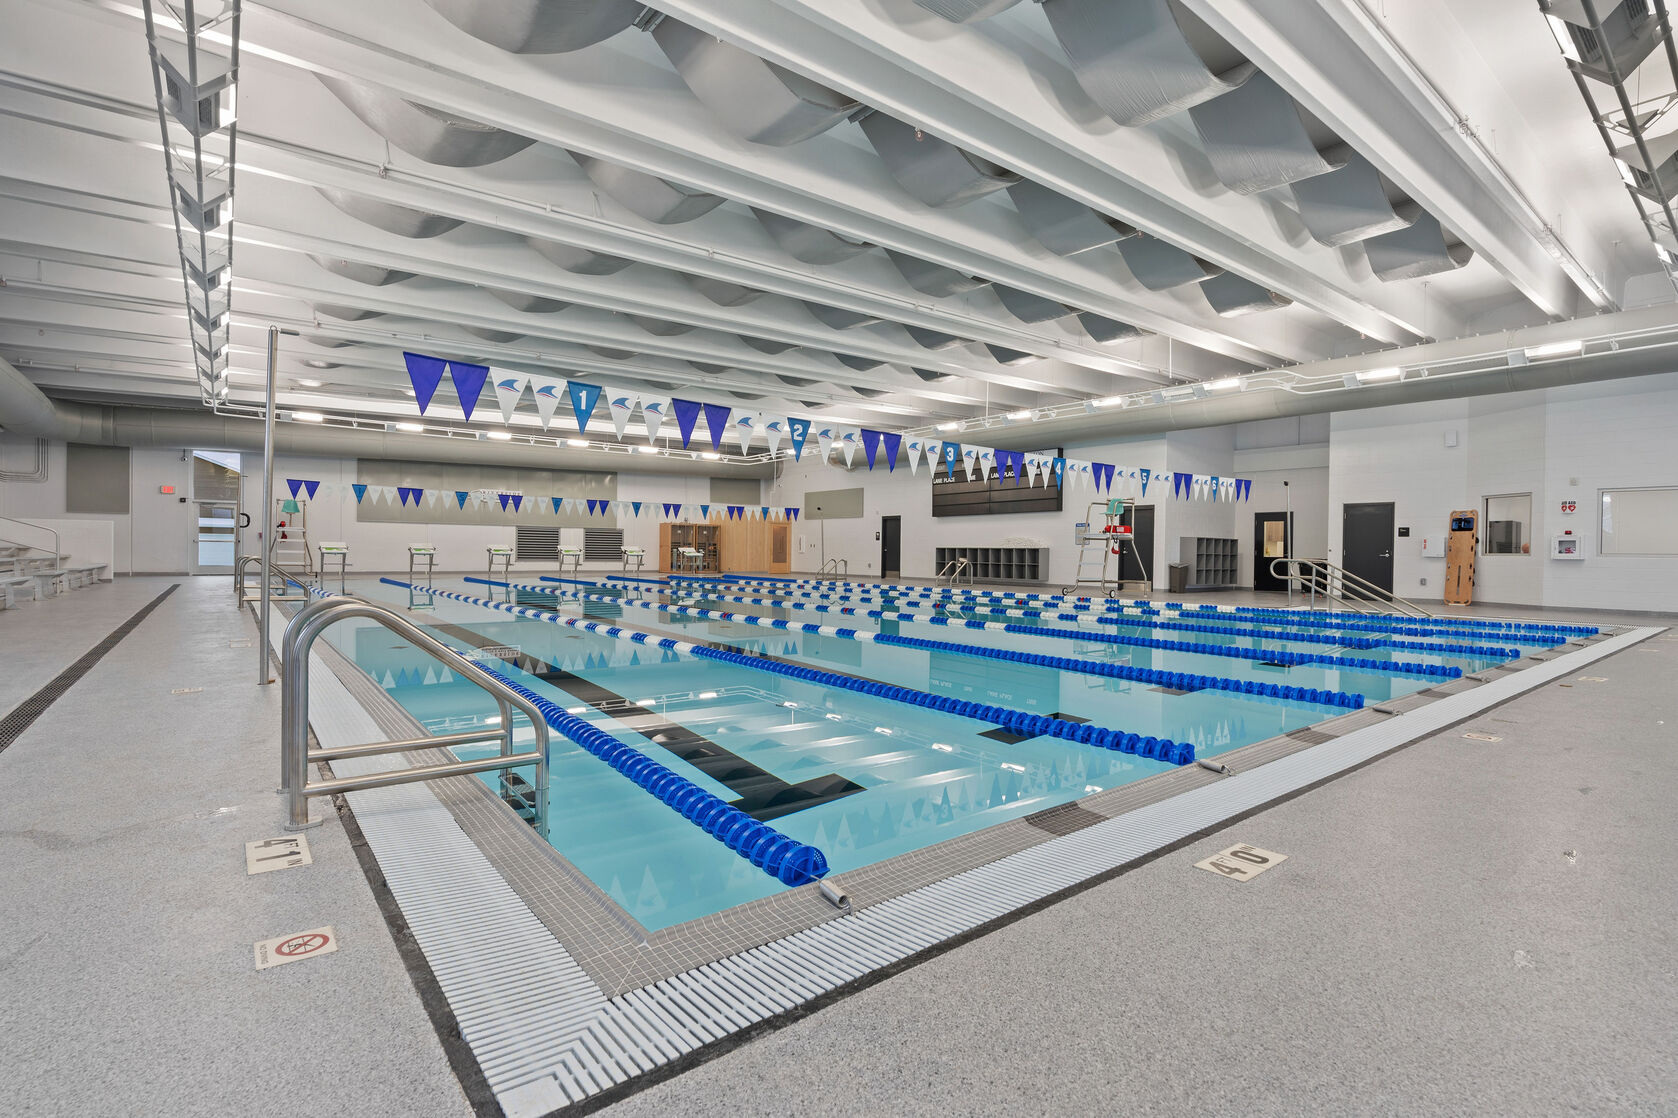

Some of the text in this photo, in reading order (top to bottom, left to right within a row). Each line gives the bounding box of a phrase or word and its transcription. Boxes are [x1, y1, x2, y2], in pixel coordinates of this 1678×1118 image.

[579, 390, 587, 410] 1
[794, 424, 803, 441] 2
[947, 447, 954, 461] 3
[1055, 462, 1062, 475] 4
[1142, 473, 1147, 484] 5
[254, 838, 298, 849] 4
[1208, 861, 1248, 875] 4
[1230, 850, 1269, 864] 0
